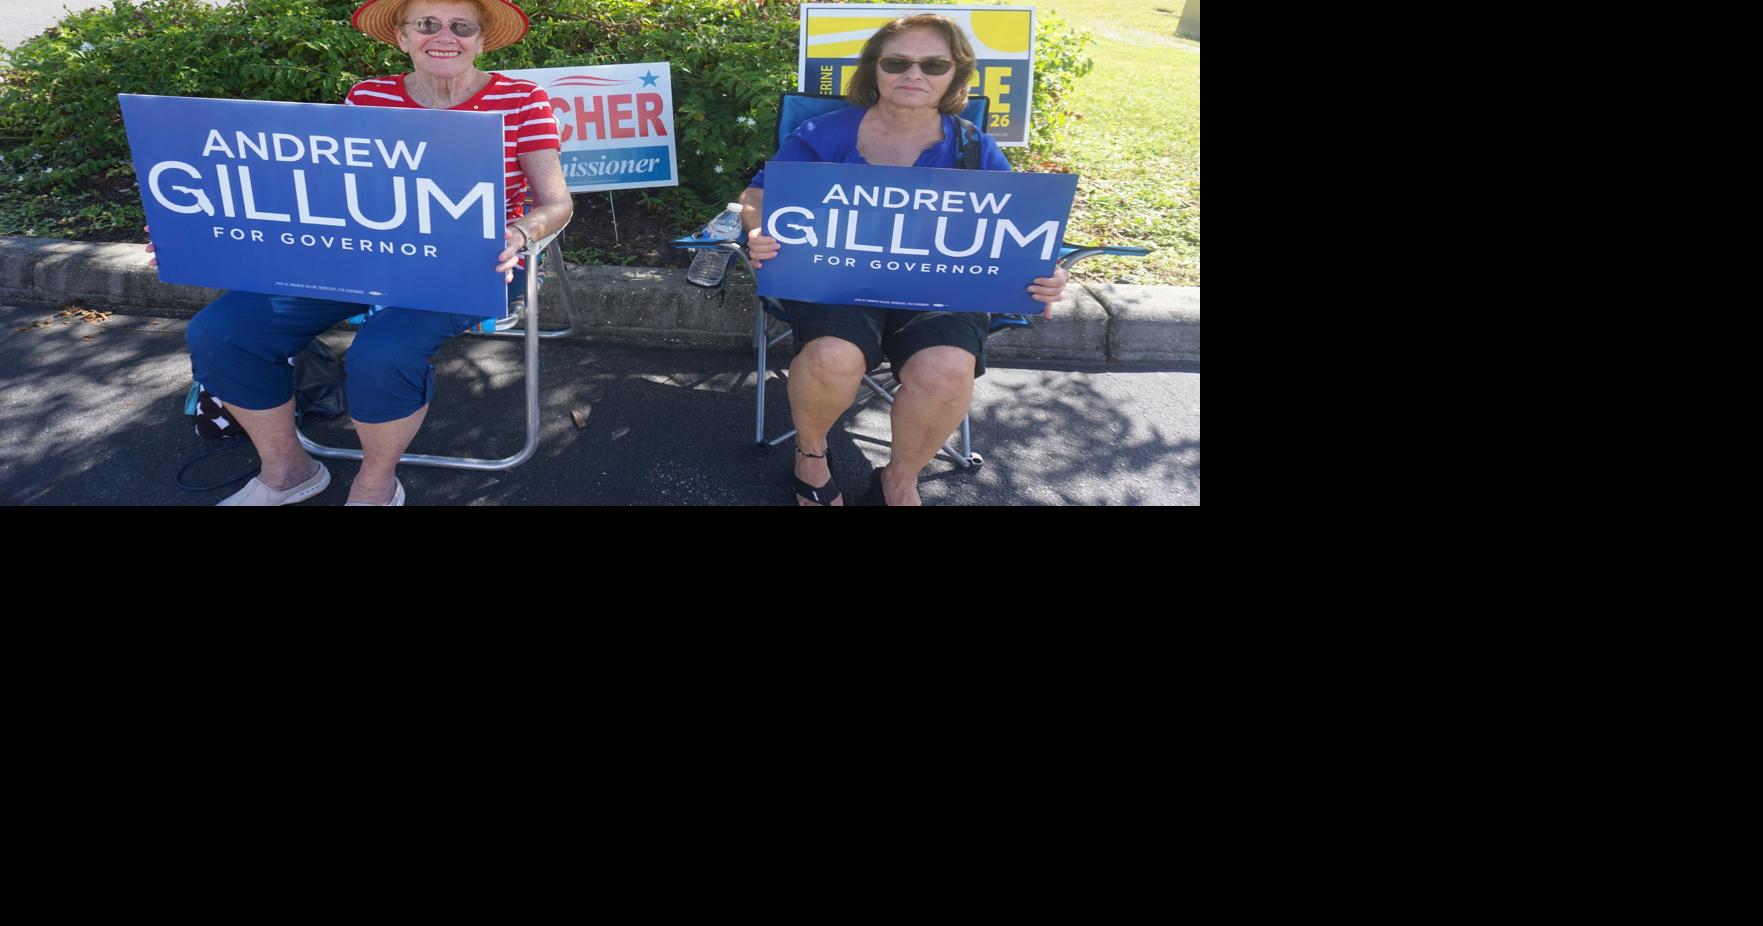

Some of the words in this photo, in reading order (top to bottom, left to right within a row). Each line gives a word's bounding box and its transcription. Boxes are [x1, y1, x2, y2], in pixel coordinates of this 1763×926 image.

[990, 114, 1010, 128] 26
[202, 129, 428, 171] ANDREW
[148, 160, 496, 240] GILLUM
[822, 183, 1012, 214] ANDREW
[213, 226, 264, 242] FOR
[280, 232, 438, 258] GOVERNOR
[767, 205, 1060, 261] GILLUM
[813, 254, 856, 268] FOR
[870, 259, 999, 275] GOVERNOR
